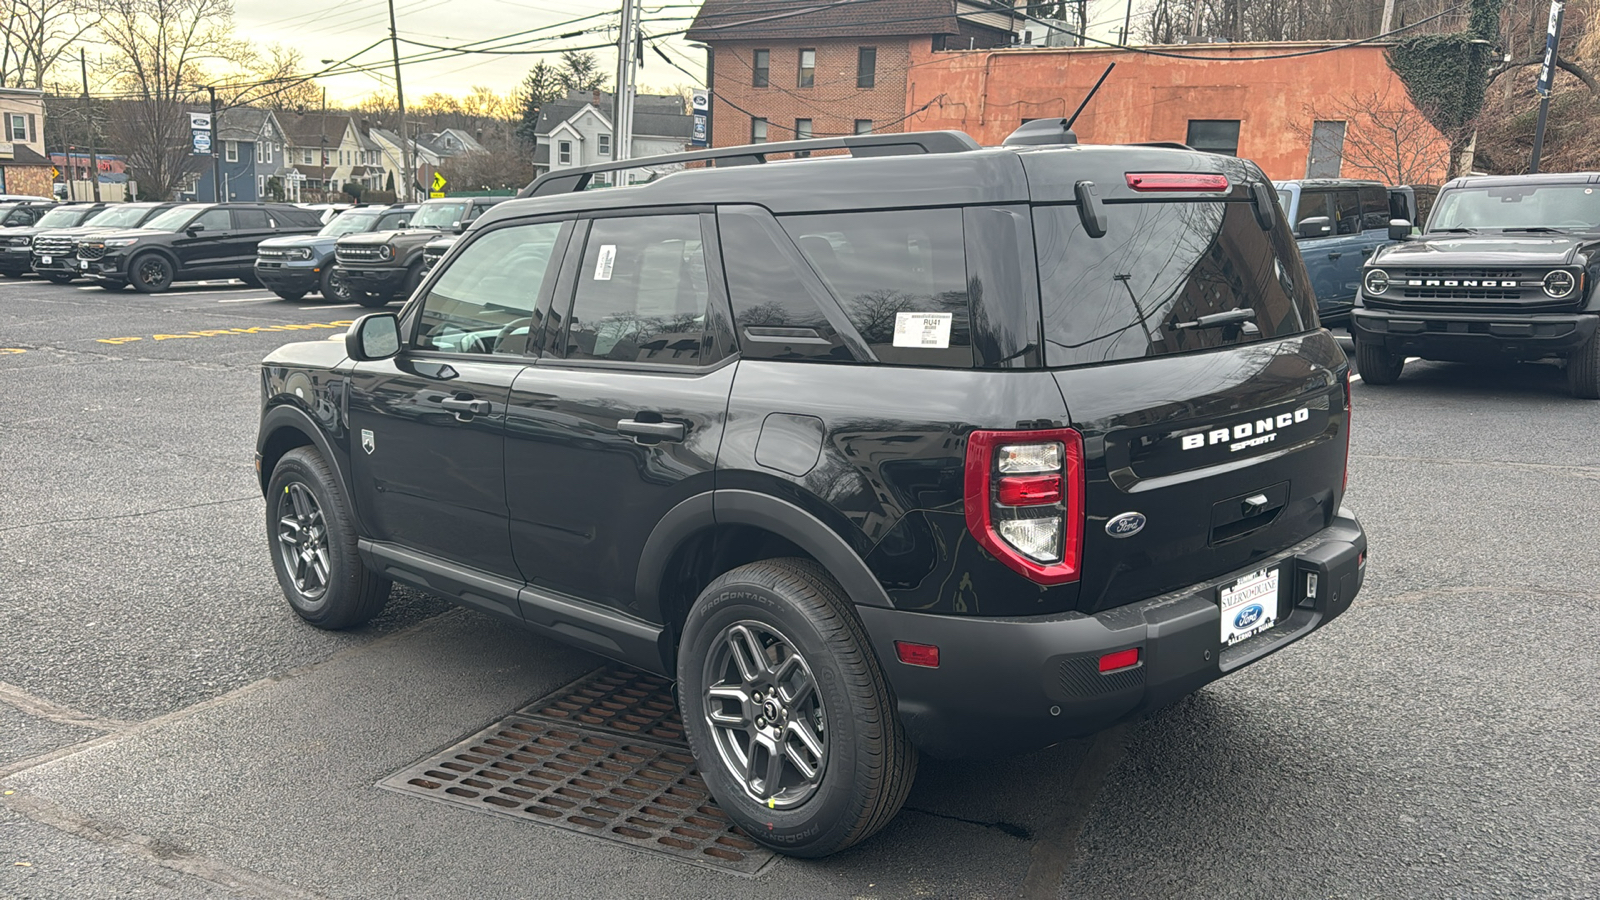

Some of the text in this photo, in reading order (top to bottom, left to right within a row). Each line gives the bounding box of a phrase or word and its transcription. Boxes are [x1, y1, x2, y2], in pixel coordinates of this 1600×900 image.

[1408, 279, 1517, 288] BRONCO
[923, 318, 941, 326] RU41
[1182, 407, 1309, 451] BRONCO
[1230, 432, 1278, 452] SPORT
[1222, 578, 1276, 608] SALERNO DUANE
